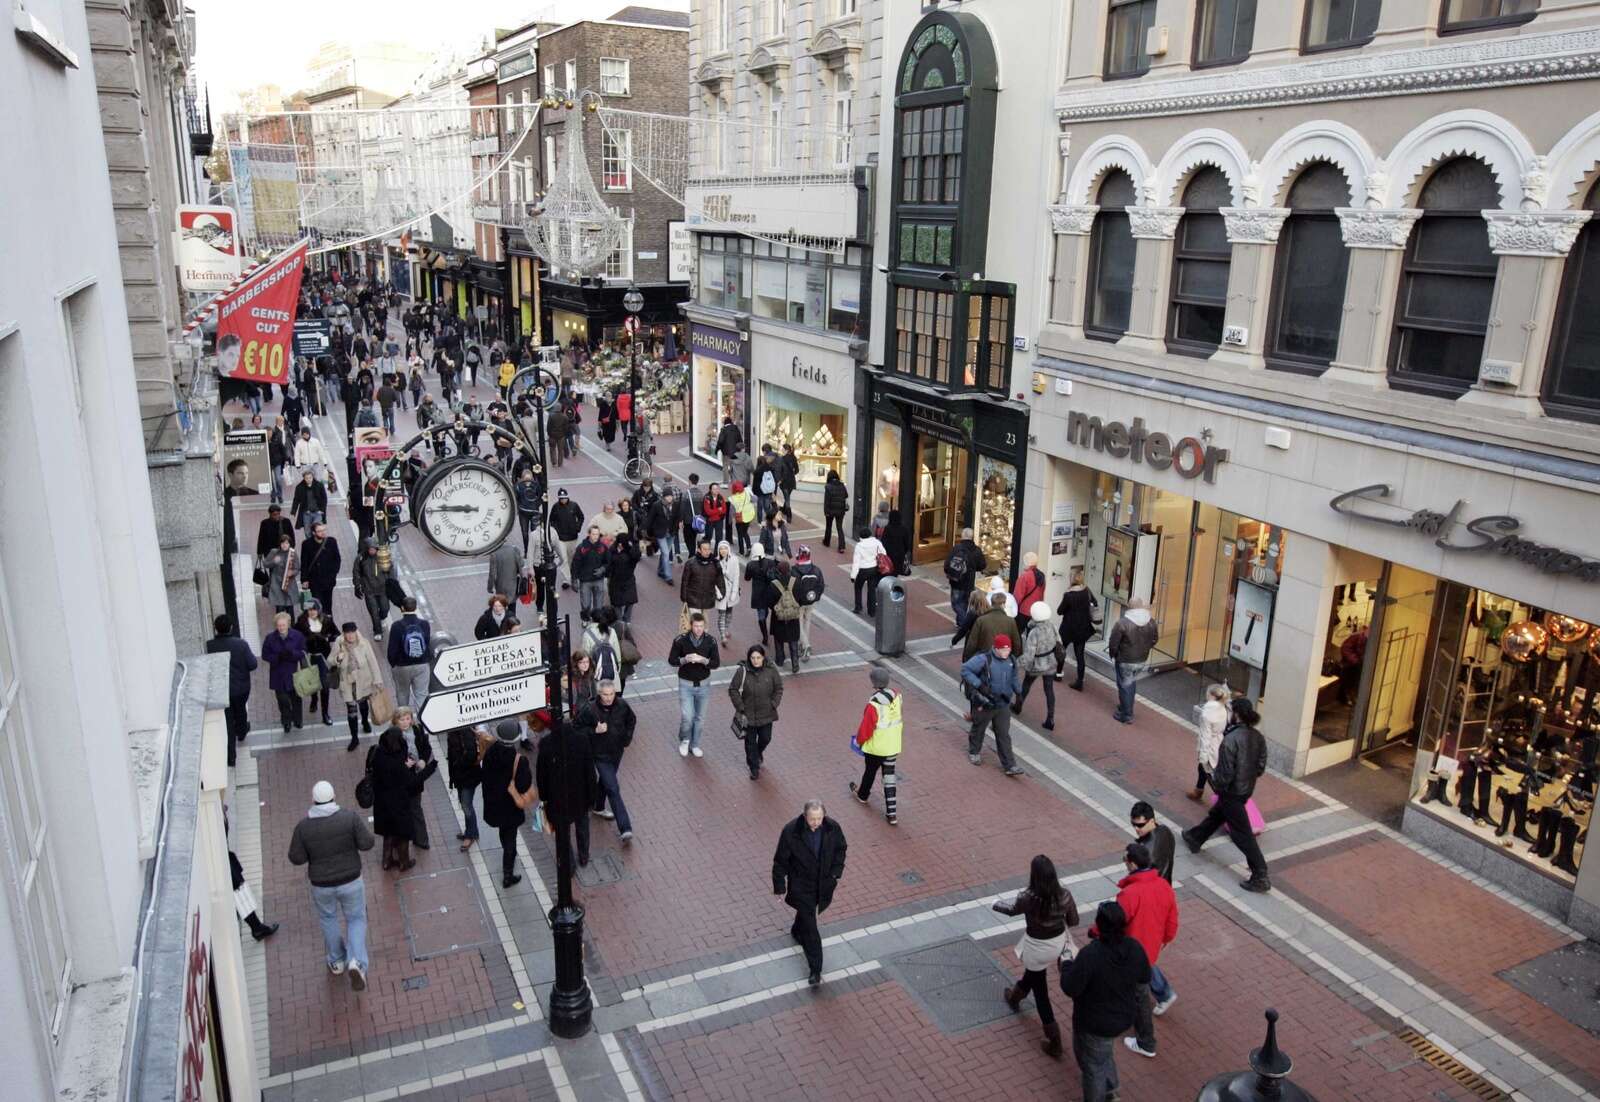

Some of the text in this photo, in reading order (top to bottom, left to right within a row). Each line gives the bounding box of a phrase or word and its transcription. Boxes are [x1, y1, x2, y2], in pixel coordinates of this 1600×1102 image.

[222, 256, 302, 319] BARBERSHOP
[251, 307, 290, 322] GENTS
[256, 322, 280, 334] CUT
[692, 332, 741, 356] PHARMACY
[244, 340, 284, 377] €10
[792, 356, 828, 385] fields
[873, 392, 881, 403] 23
[1005, 432, 1016, 446] 23
[1067, 410, 1229, 485] meteor
[444, 475, 453, 486] 11
[460, 471, 471, 481] 12
[480, 472, 484, 482] 1
[431, 488, 442, 500] 10
[443, 481, 491, 502] POWERSCOURT
[493, 480, 502, 494] 2
[500, 498, 508, 510] 3
[440, 508, 495, 535] SHOPPING CENTRE
[494, 518, 502, 528] 4
[433, 524, 441, 535] 8
[483, 530, 490, 541] 5
[450, 534, 457, 546] 7
[465, 537, 474, 547] 6
[474, 642, 510, 656] EAGLAIS
[448, 646, 536, 674] ST. TERESA'S
[500, 657, 538, 671] CHURCH
[456, 679, 529, 703] Powerscourt
[457, 694, 522, 715] Townhouse
[457, 713, 487, 724] Shopping
